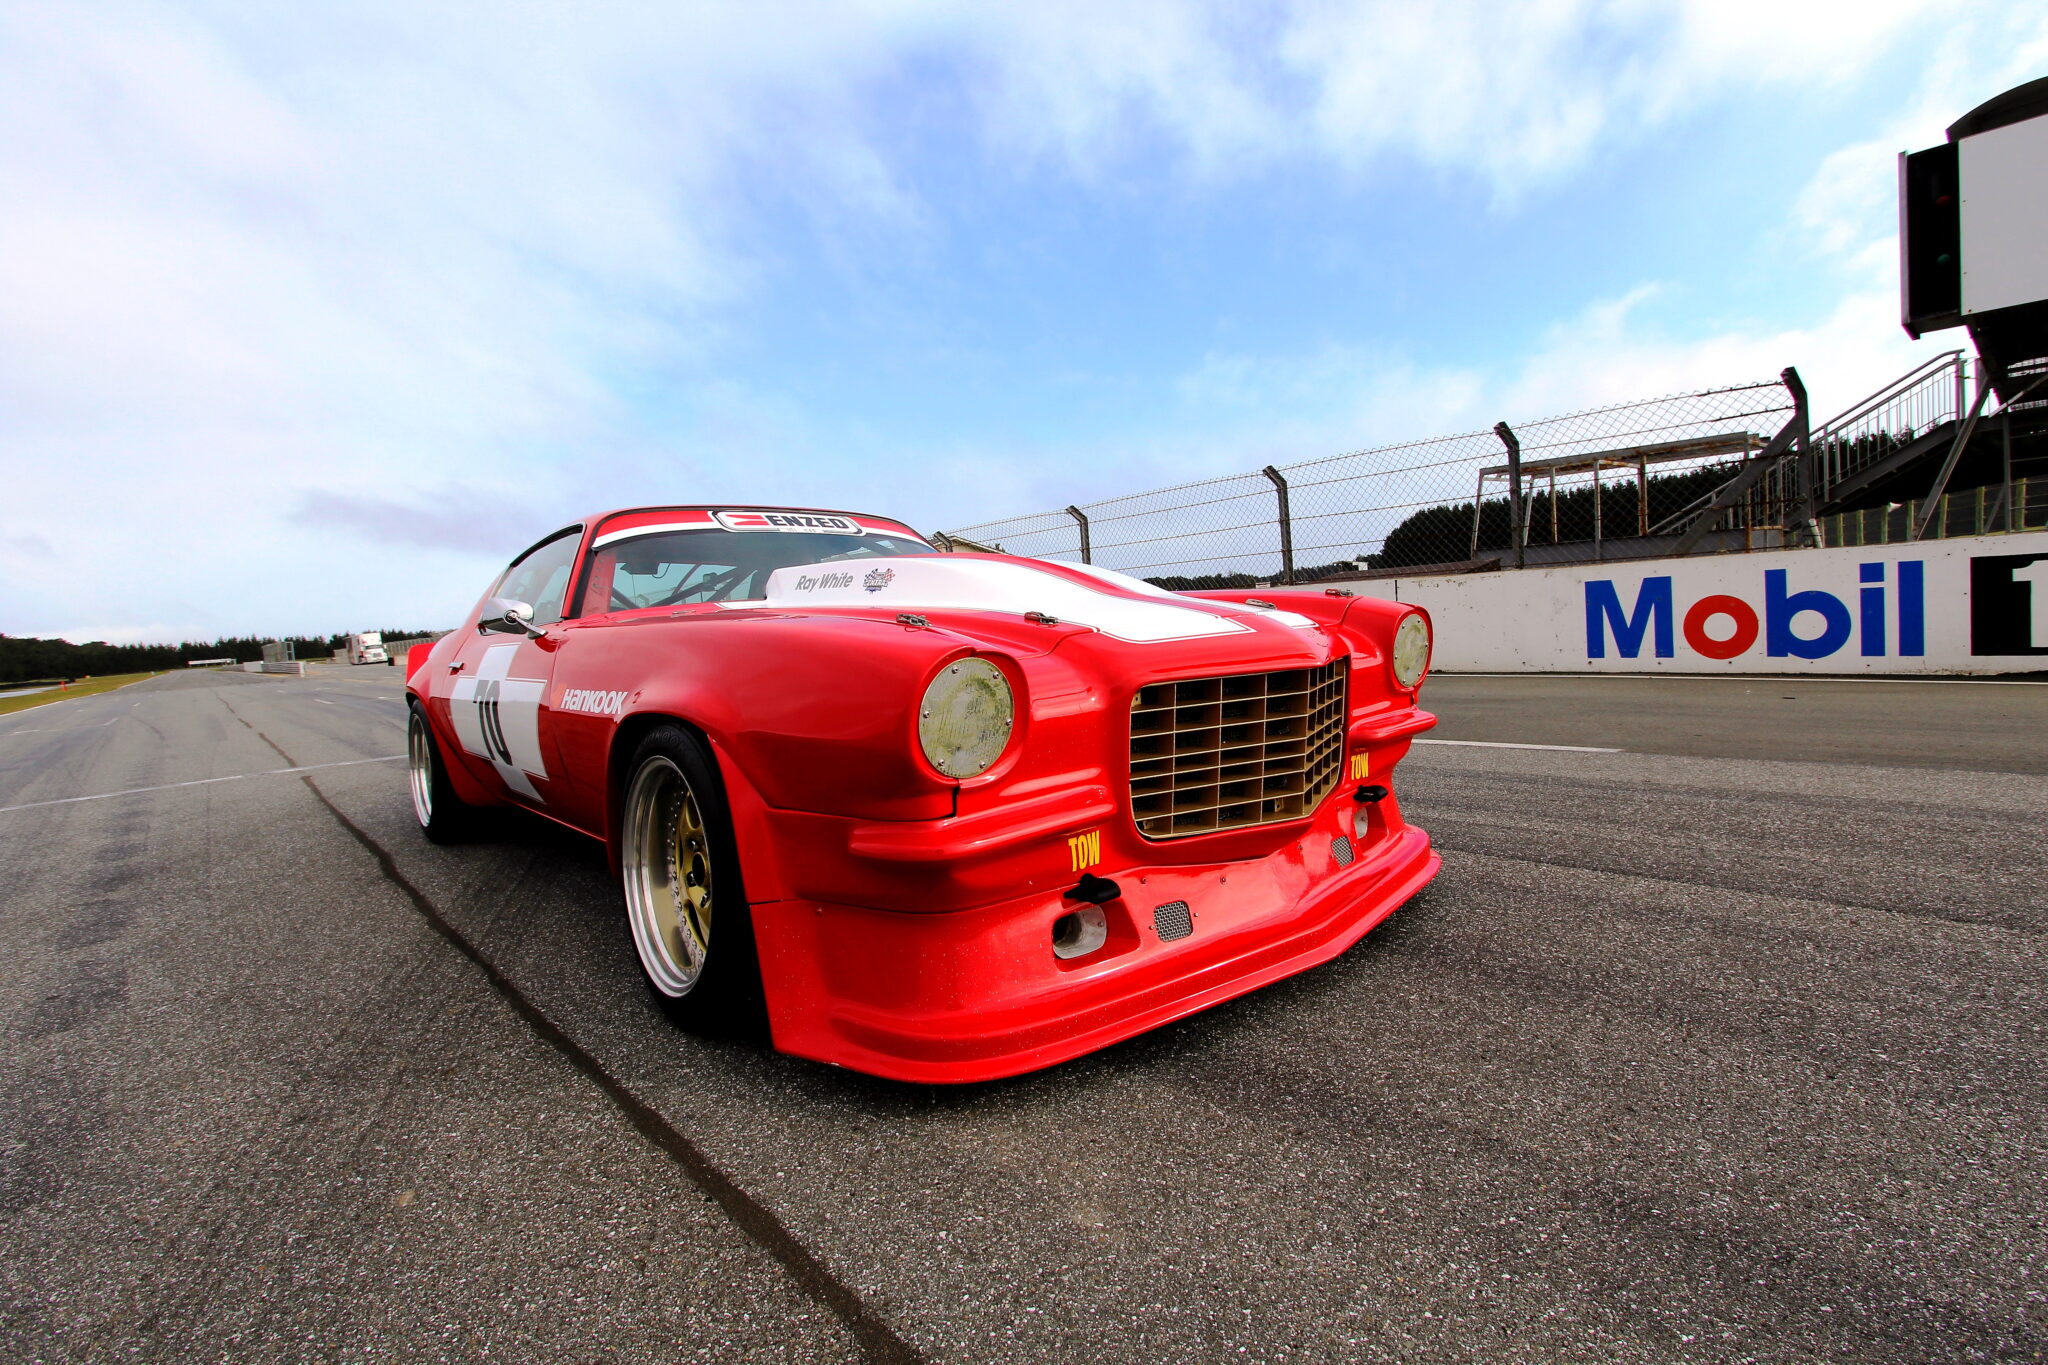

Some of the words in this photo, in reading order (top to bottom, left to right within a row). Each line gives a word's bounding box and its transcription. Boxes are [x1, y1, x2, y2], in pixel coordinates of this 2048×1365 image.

[765, 515, 849, 529] ENZED
[795, 575, 820, 592] Ray
[818, 572, 854, 589] White
[1585, 560, 1925, 660] Mobil
[473, 680, 513, 766] 10
[1350, 752, 1369, 780] TOW
[1068, 830, 1100, 872] TOW
